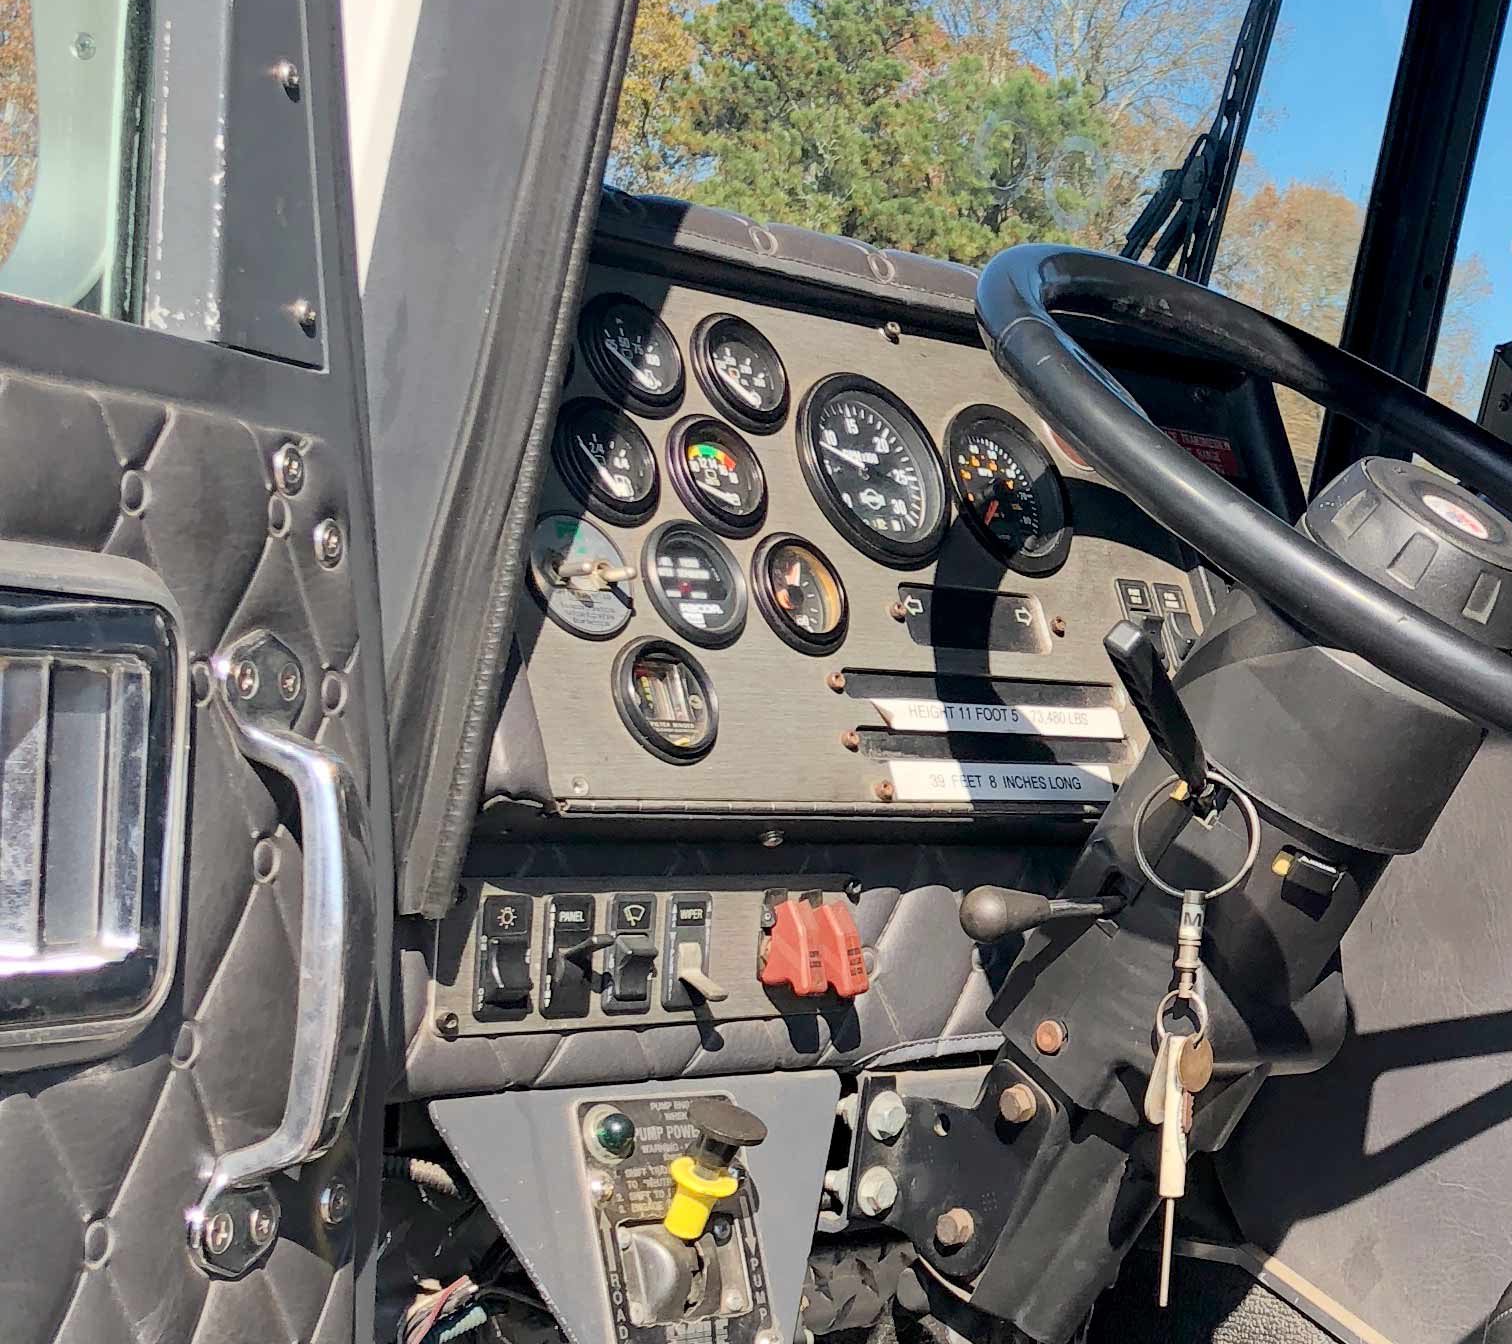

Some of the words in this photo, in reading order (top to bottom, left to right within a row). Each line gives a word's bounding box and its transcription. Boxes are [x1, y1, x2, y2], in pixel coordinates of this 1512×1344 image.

[844, 418, 859, 434] 15
[872, 436, 889, 453] 20
[890, 468, 908, 485] 25
[891, 498, 908, 515] 30
[908, 704, 955, 720] HEIGHT
[959, 706, 971, 721] 11
[976, 706, 1009, 722] FOOT
[1011, 708, 1019, 722] 5
[1067, 712, 1089, 726] LBS
[929, 774, 945, 788] 39
[951, 774, 982, 788] FEET
[988, 775, 998, 788] 8
[1002, 775, 1048, 790] INCHES
[1049, 776, 1081, 790] LONG
[559, 910, 585, 923] PANEL
[680, 908, 704, 920] WIPER
[1184, 912, 1203, 928] M
[634, 1126, 663, 1142] PUMP
[750, 1258, 768, 1320] PUMP
[609, 1273, 629, 1340] ROAD
